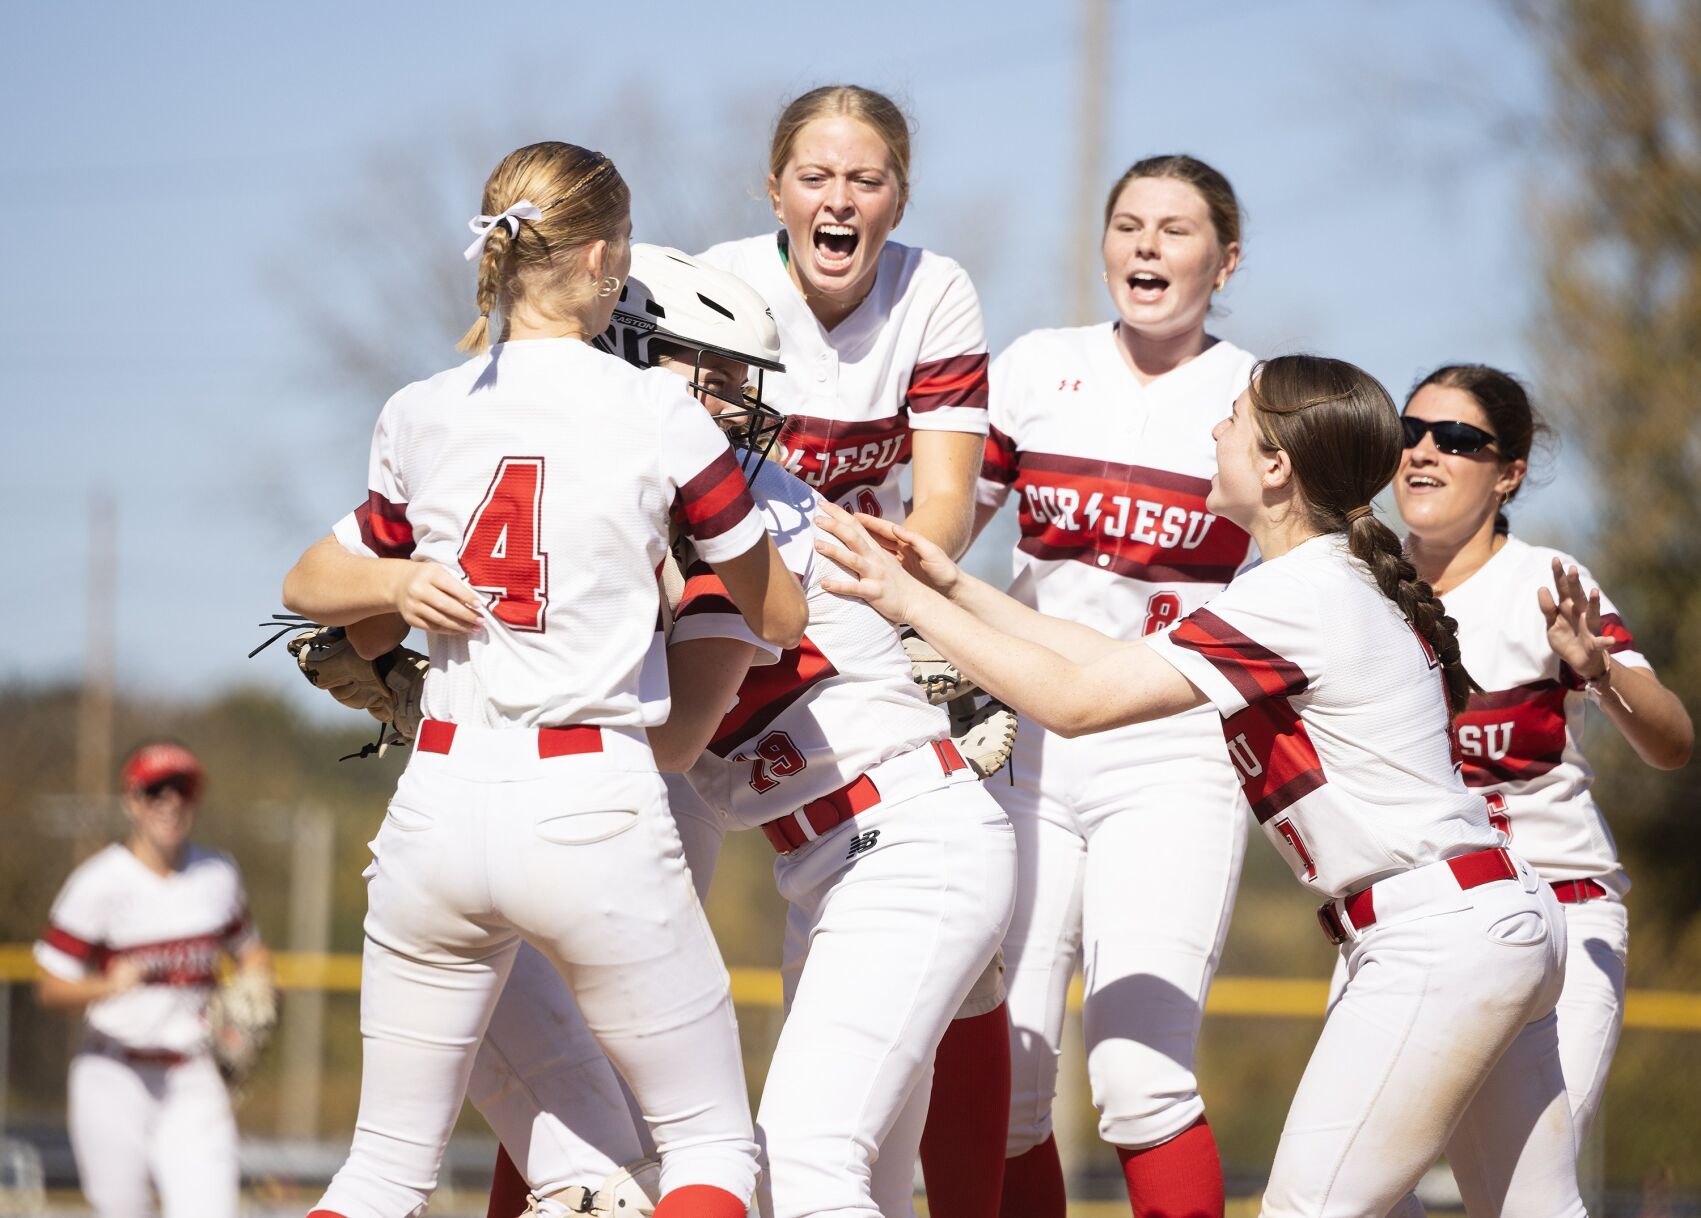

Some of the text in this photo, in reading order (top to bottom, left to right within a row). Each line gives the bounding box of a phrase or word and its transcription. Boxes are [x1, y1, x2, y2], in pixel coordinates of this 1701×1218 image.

[806, 434, 905, 487] JESU
[457, 456, 549, 634] 4
[1025, 484, 1216, 549] COR JESU
[1459, 721, 1514, 760] SU
